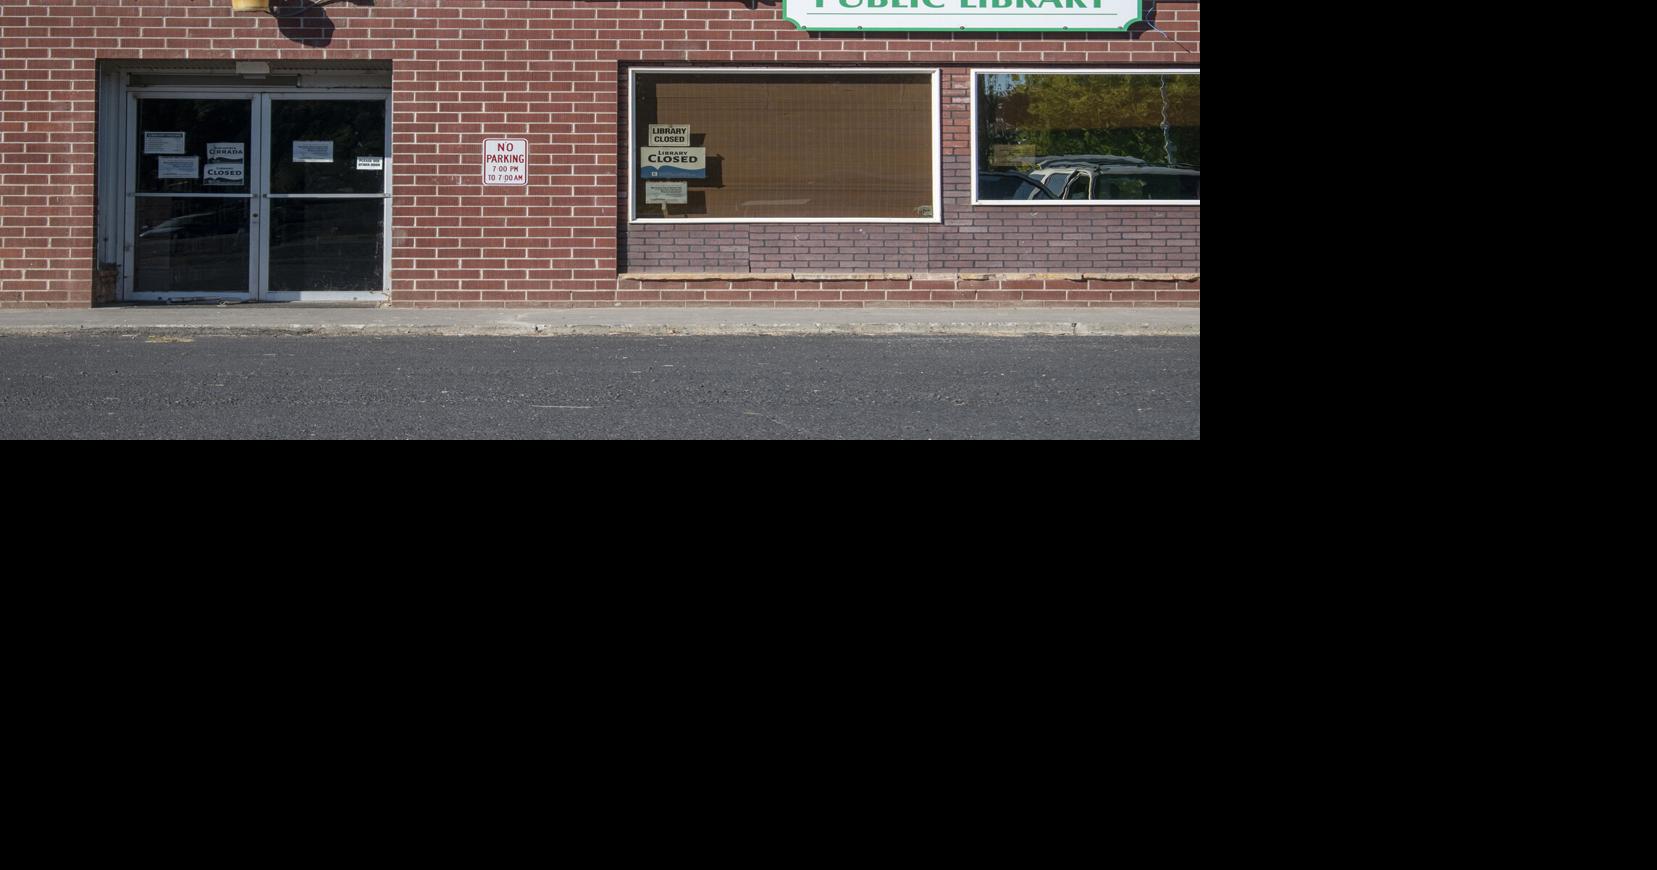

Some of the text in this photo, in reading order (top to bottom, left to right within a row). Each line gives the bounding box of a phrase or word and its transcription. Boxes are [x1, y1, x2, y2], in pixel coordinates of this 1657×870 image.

[497, 143, 514, 152] NO
[486, 154, 525, 163] PARKING
[648, 154, 698, 163] CLOSED
